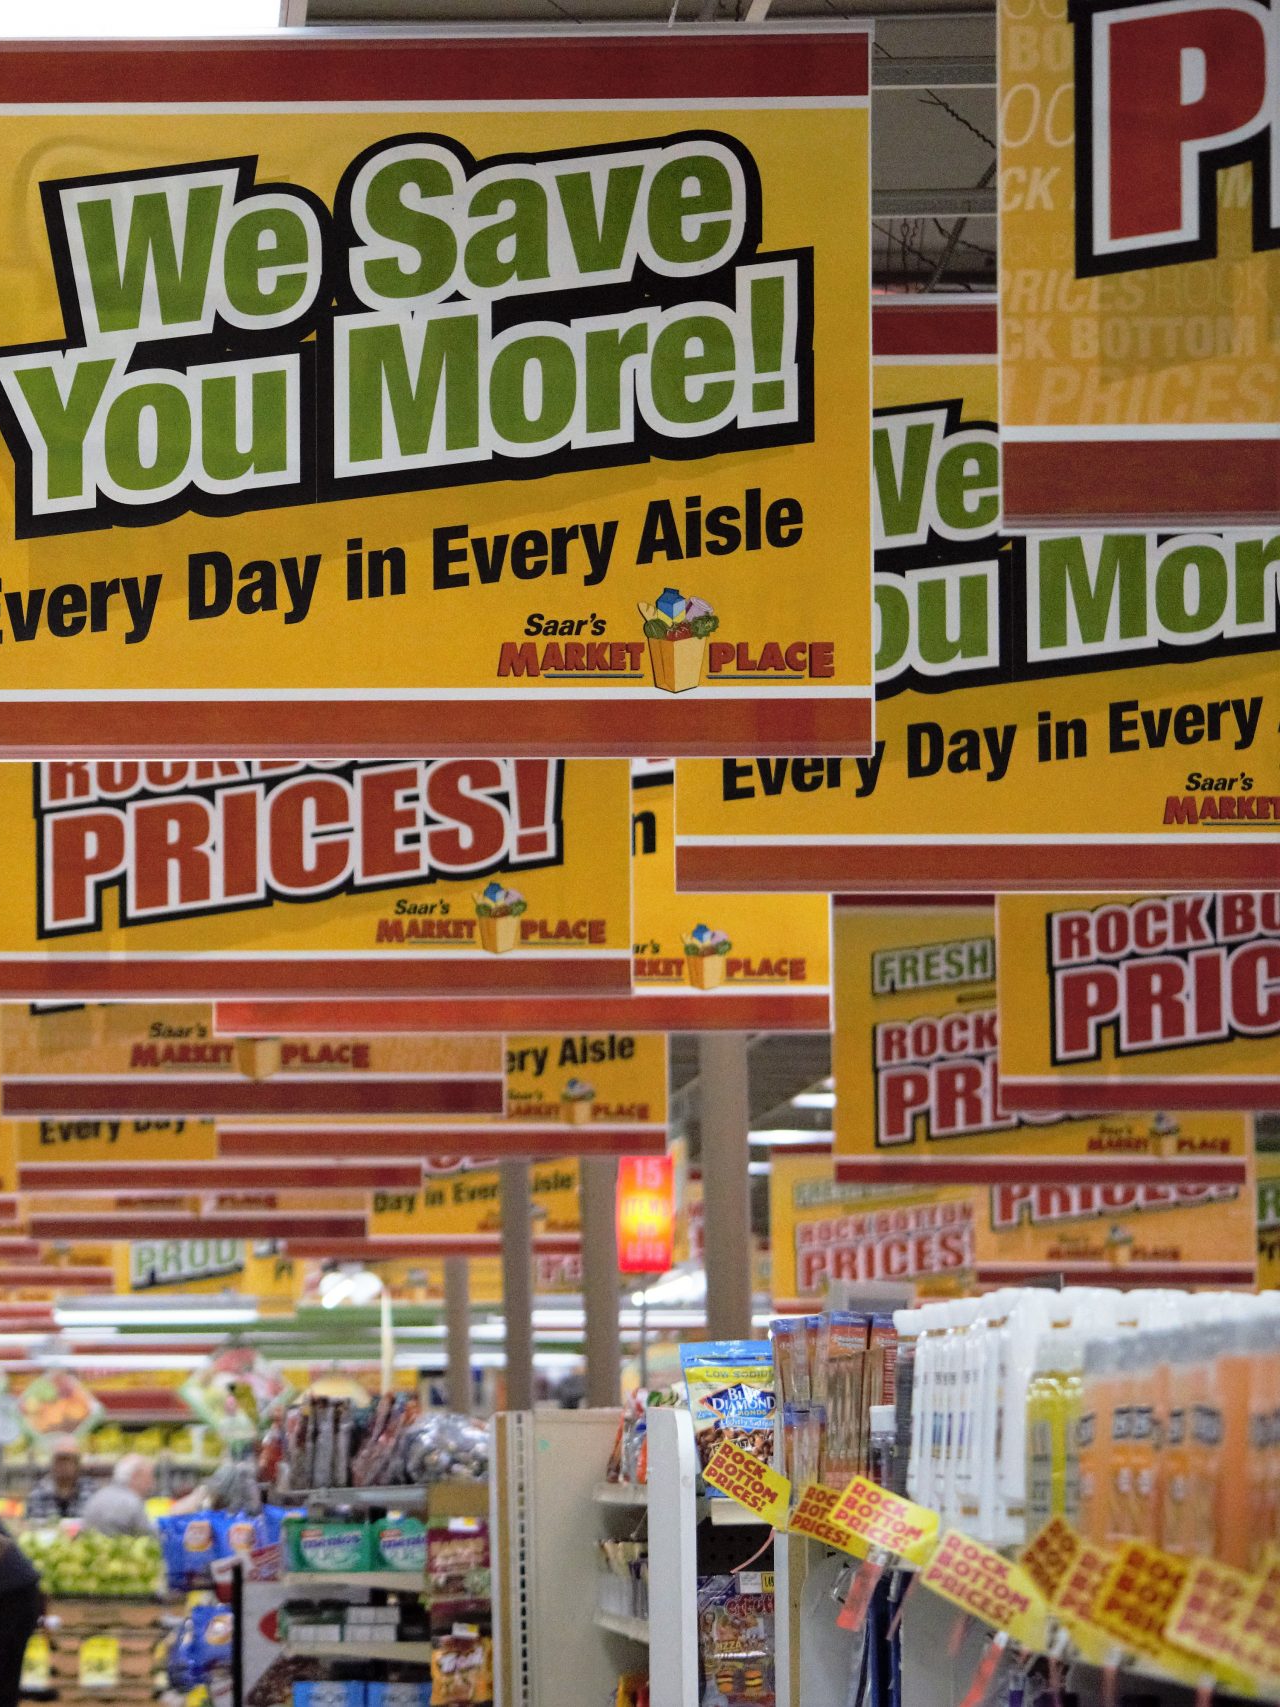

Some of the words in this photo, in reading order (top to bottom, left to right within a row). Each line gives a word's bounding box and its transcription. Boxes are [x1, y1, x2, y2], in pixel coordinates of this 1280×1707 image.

[59, 168, 322, 347] We
[349, 140, 746, 312] Save
[333, 260, 799, 478] More!
[188, 551, 322, 625] Day
[346, 538, 406, 601] in
[432, 521, 618, 590] Every
[636, 488, 804, 565] Aisle
[1026, 533, 1280, 662] Mor
[524, 612, 606, 636] Saar's
[497, 642, 644, 677] MARKET
[709, 642, 835, 678] PLACE
[907, 722, 1018, 782] Day
[1037, 711, 1088, 763] in
[1109, 696, 1264, 754] Every
[1185, 772, 1254, 791] Saar's
[43, 762, 559, 931] PRICES!
[394, 899, 450, 915] Saar's
[375, 919, 477, 943] MARKET
[520, 919, 606, 945] PLACE
[1053, 894, 1214, 965] ROCK
[633, 958, 685, 980] RKET
[726, 958, 806, 981] PLACE
[876, 944, 991, 988] FRESH
[1057, 940, 1280, 1060] PRIC
[280, 1043, 370, 1068] PLACE
[558, 1034, 635, 1067] Aisle
[712, 1396, 776, 1411] DIAMOND
[711, 1455, 779, 1504] BOTTOM
[720, 1443, 767, 1480] ROCK
[705, 1466, 766, 1513] PRICES!
[805, 1485, 839, 1507] ROC
[852, 1482, 909, 1517] ROCK
[790, 1515, 851, 1547] PRICES!
[834, 1509, 909, 1552] PRICES!
[843, 1495, 924, 1541] BOTTOM
[946, 1535, 1010, 1579] ROCK
[936, 1551, 1030, 1613] BOTTOM
